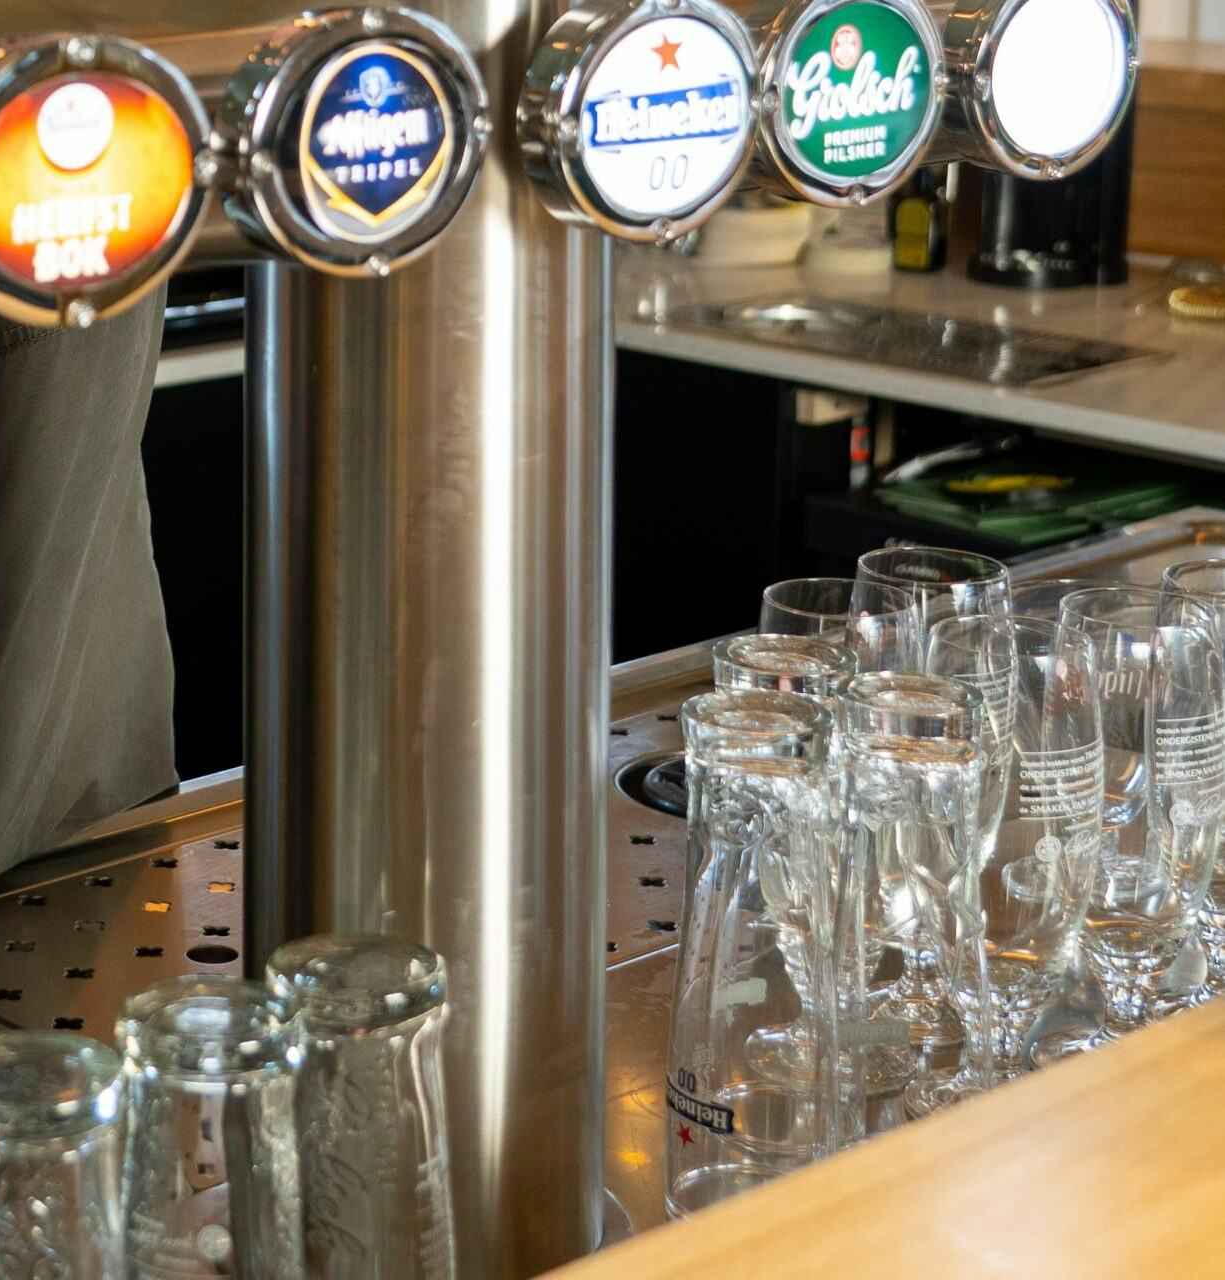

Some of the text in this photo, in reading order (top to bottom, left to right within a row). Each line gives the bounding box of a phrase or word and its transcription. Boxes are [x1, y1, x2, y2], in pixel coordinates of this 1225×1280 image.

[594, 90, 740, 142] Heineken
[785, 45, 918, 140] Grolsch
[317, 108, 429, 160] Affligem
[824, 125, 887, 148] PREMIUM
[824, 141, 887, 164] PILSNER
[335, 158, 422, 184] TRIPEL
[33, 232, 110, 283] BOK
[666, 1083, 728, 1129] Heineke
